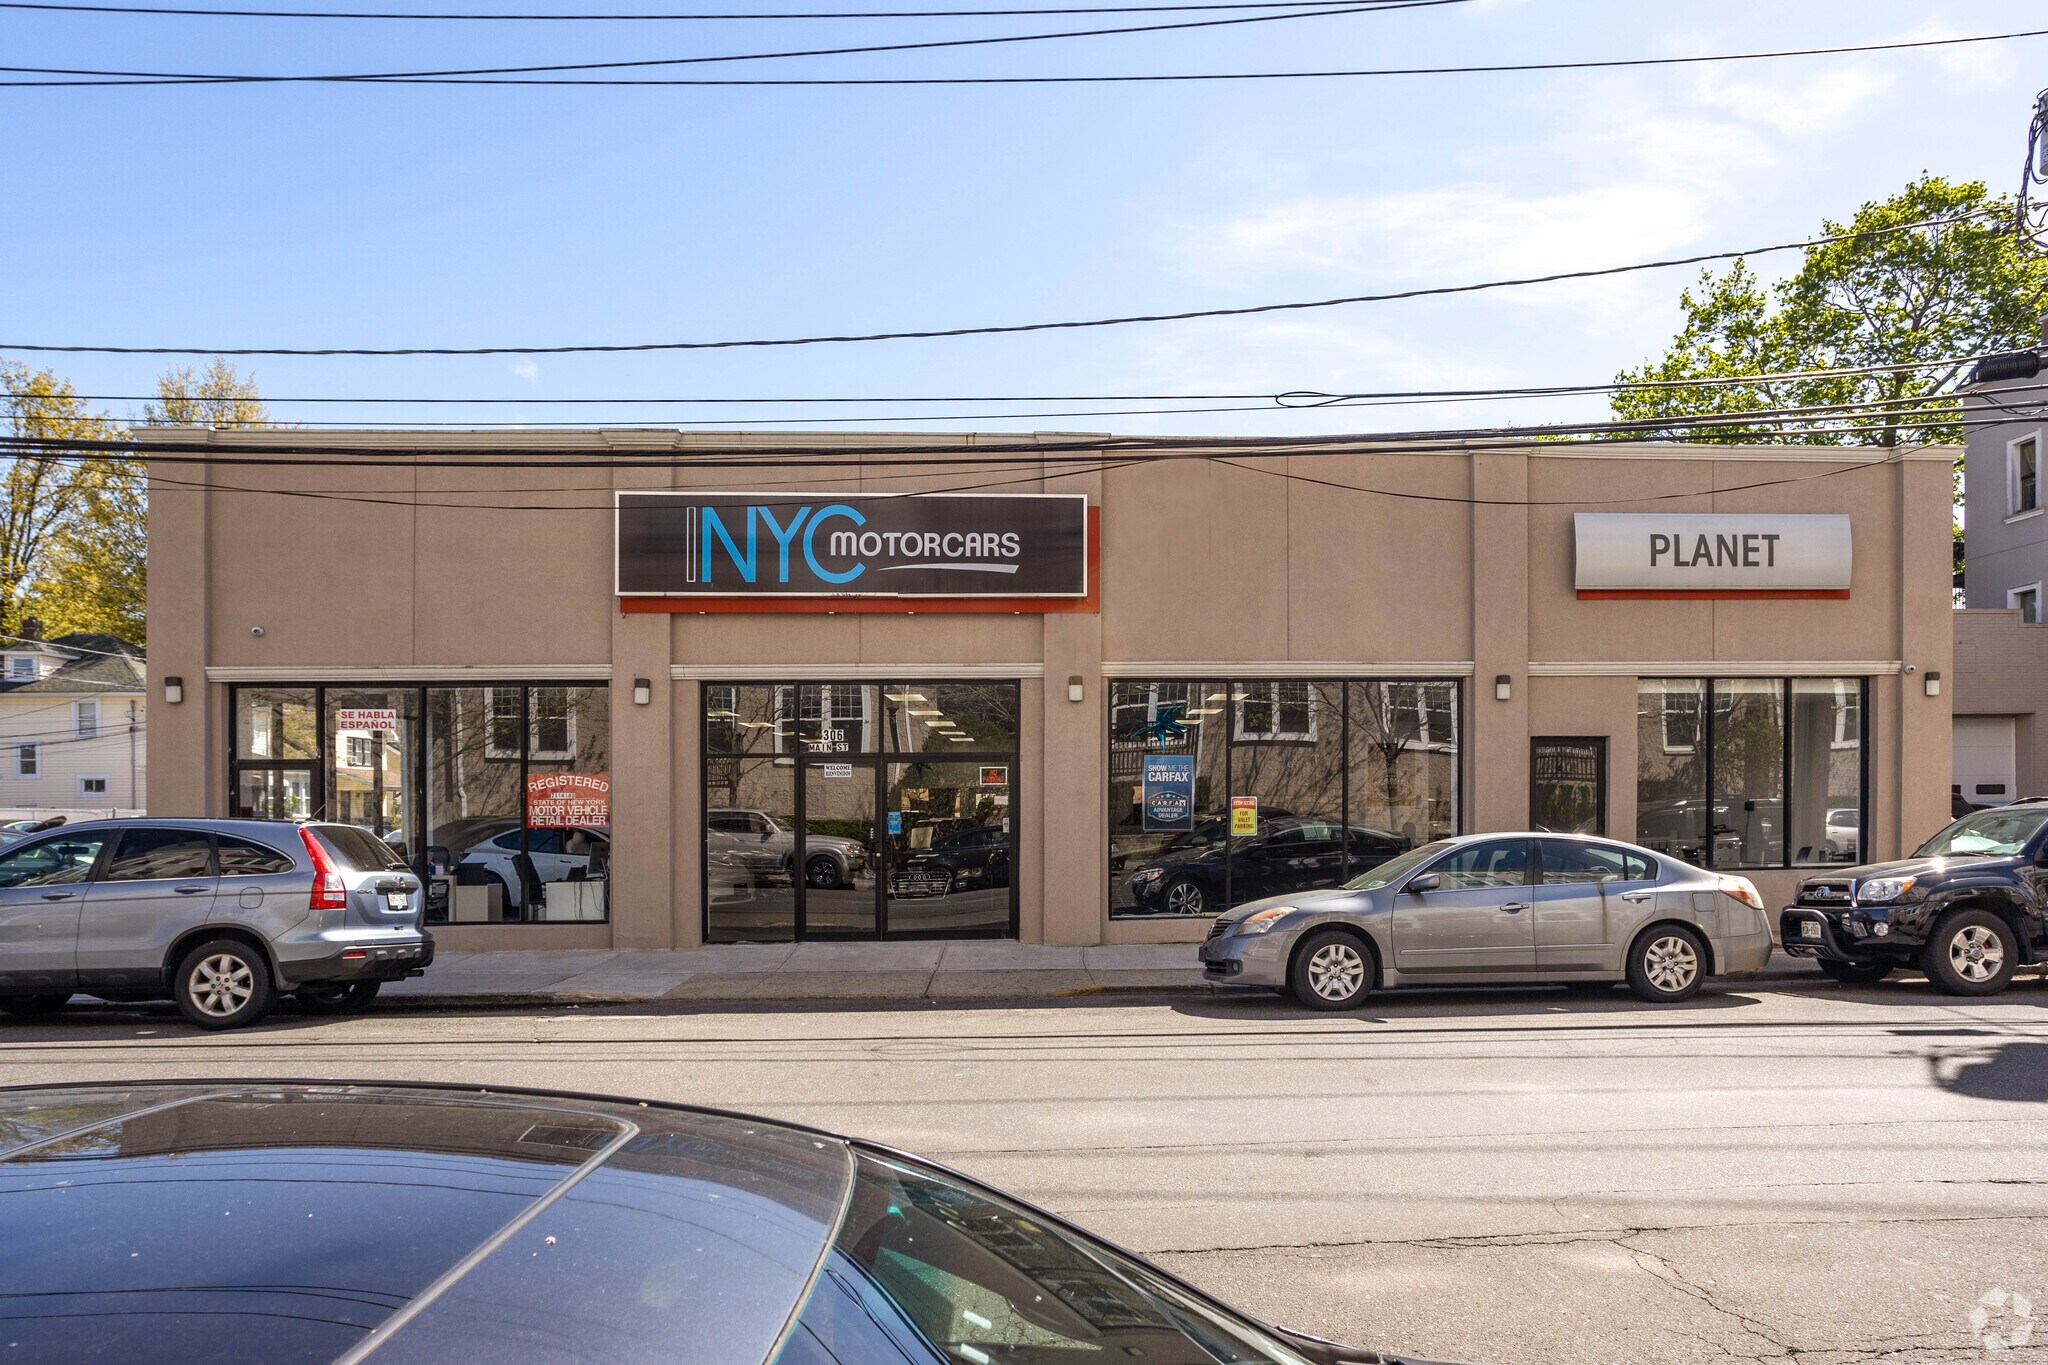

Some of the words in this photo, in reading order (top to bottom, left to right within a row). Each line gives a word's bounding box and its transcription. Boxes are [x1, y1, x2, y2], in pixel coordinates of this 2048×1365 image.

[702, 504, 867, 584] NYC
[830, 532, 1021, 557] MOTORCARS
[1650, 534, 1780, 567] PLANET
[341, 711, 354, 719] SE
[358, 711, 394, 719] HABLA
[341, 720, 395, 729] ESPAÑOL
[823, 730, 843, 741] 306
[837, 743, 848, 751] ST
[1148, 772, 1189, 782] CARFAX
[528, 775, 609, 792] REGISTERED
[529, 806, 565, 815] MOTOR
[567, 806, 607, 815] VEHICLE
[531, 816, 564, 825] RETAIL
[565, 816, 606, 825] DEALER
